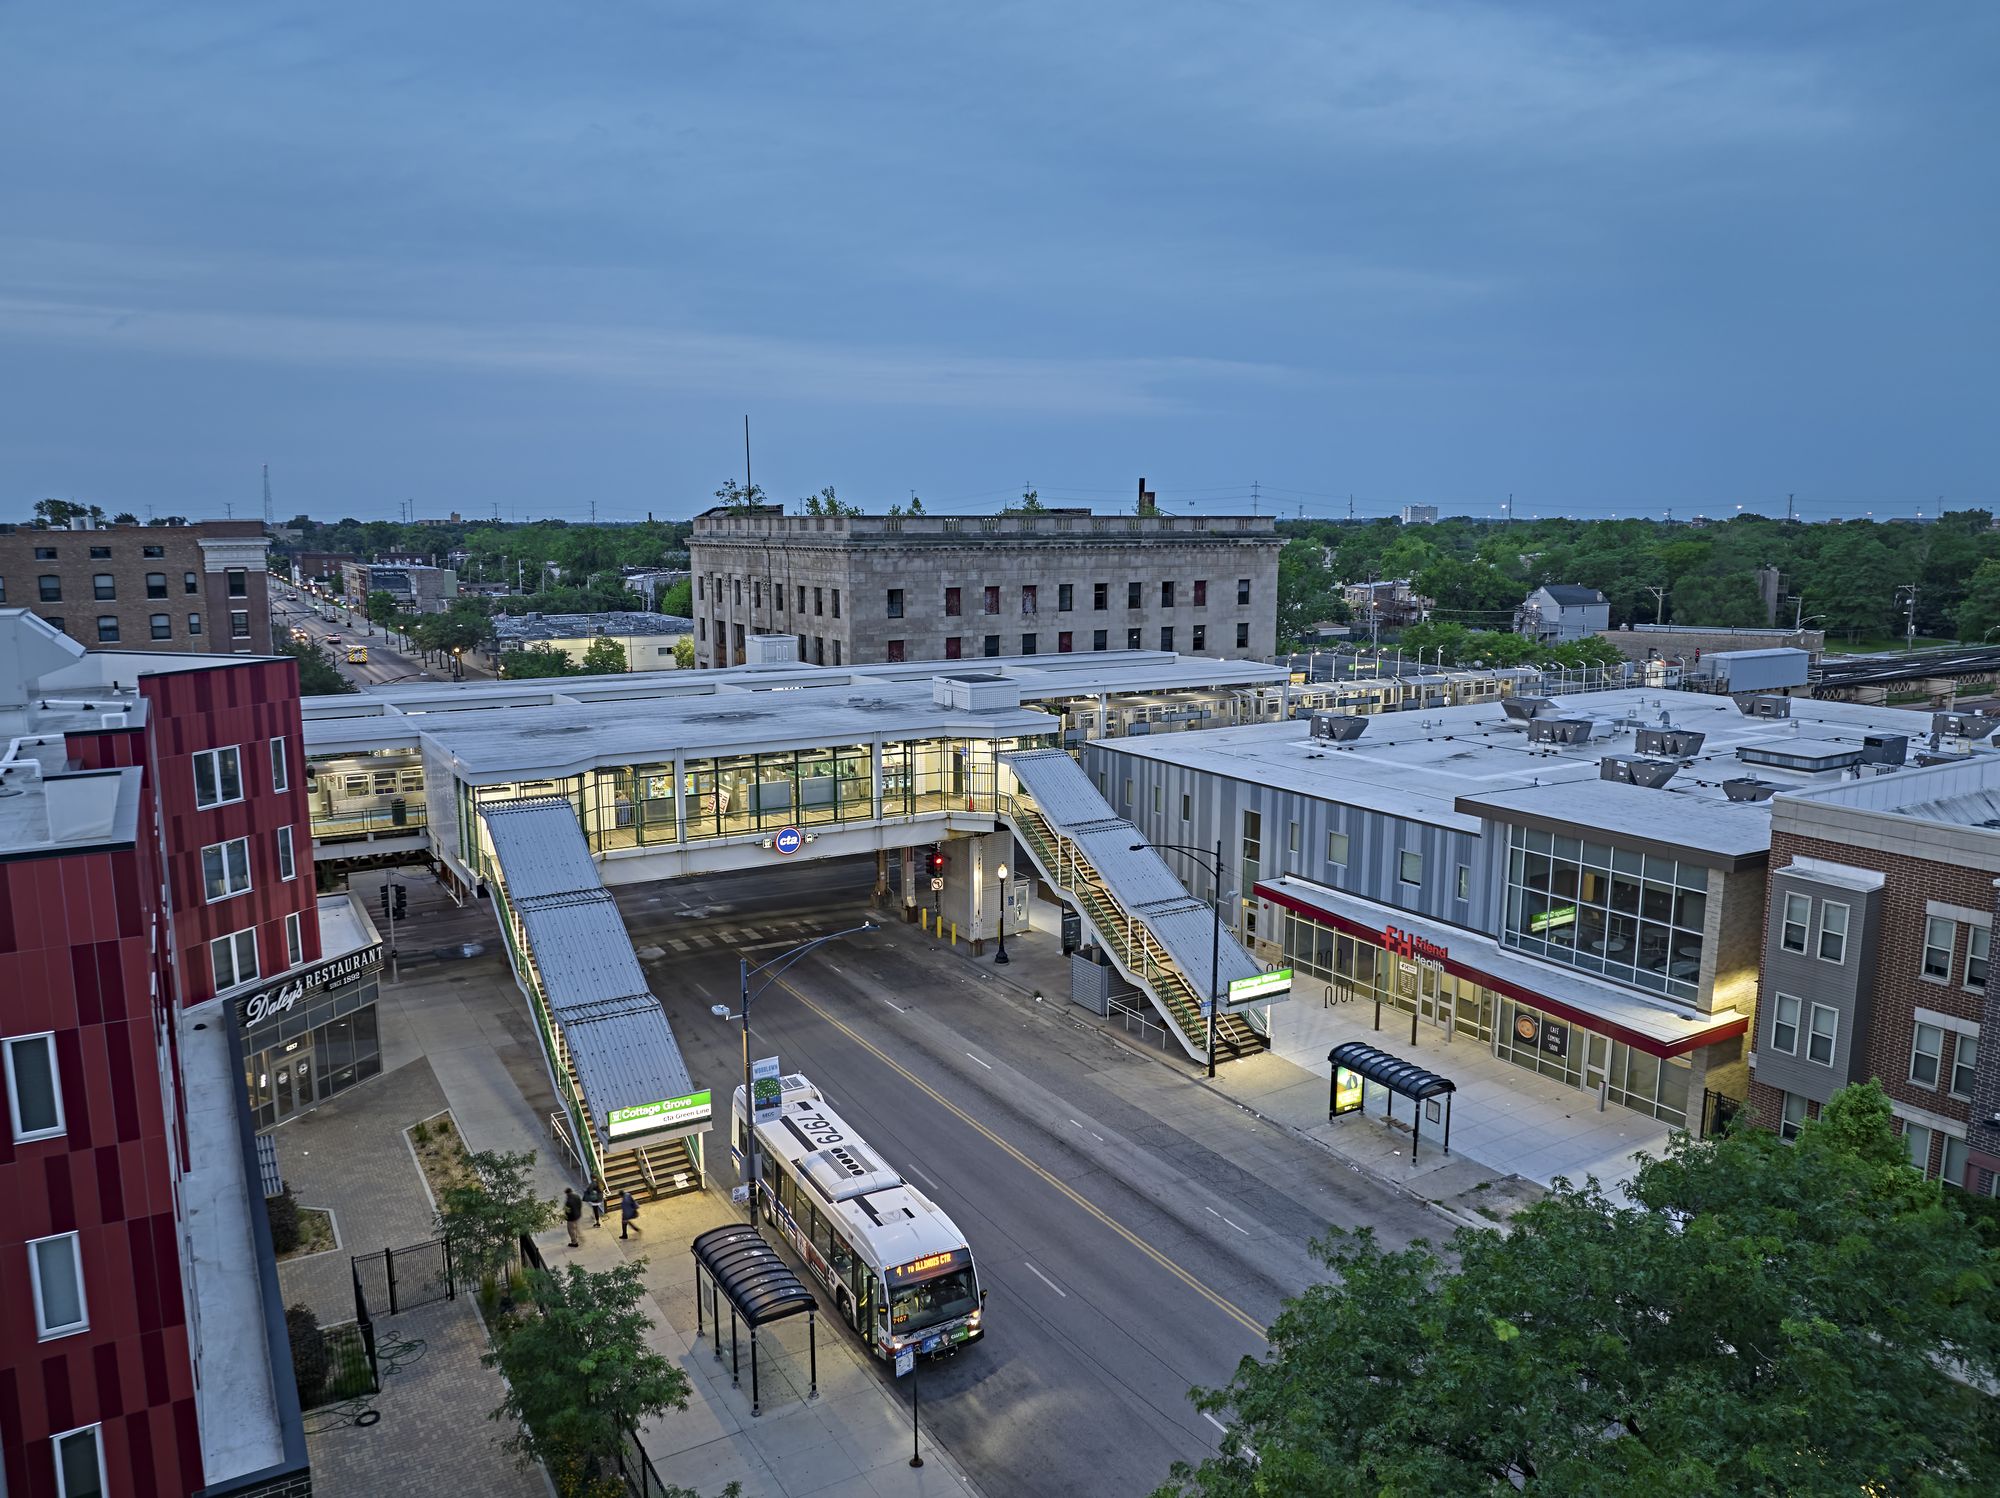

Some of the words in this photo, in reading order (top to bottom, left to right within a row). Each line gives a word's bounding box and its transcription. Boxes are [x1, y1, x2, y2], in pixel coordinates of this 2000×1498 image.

[1381, 925, 1413, 960] FH
[1415, 936, 1448, 959] Friend
[1413, 952, 1445, 973] Health
[246, 980, 303, 1028] Daley's
[305, 946, 383, 989] RESTAURANT
[329, 981, 342, 990] SINCE
[343, 971, 361, 985] 1892
[622, 1104, 660, 1119] Cottage
[663, 1098, 692, 1111] Grove
[676, 1111, 695, 1120] Green
[696, 1107, 710, 1115] Line
[797, 1113, 844, 1144] 7979
[915, 1256, 940, 1271] ILLINOIS
[940, 1253, 951, 1264] CTR
